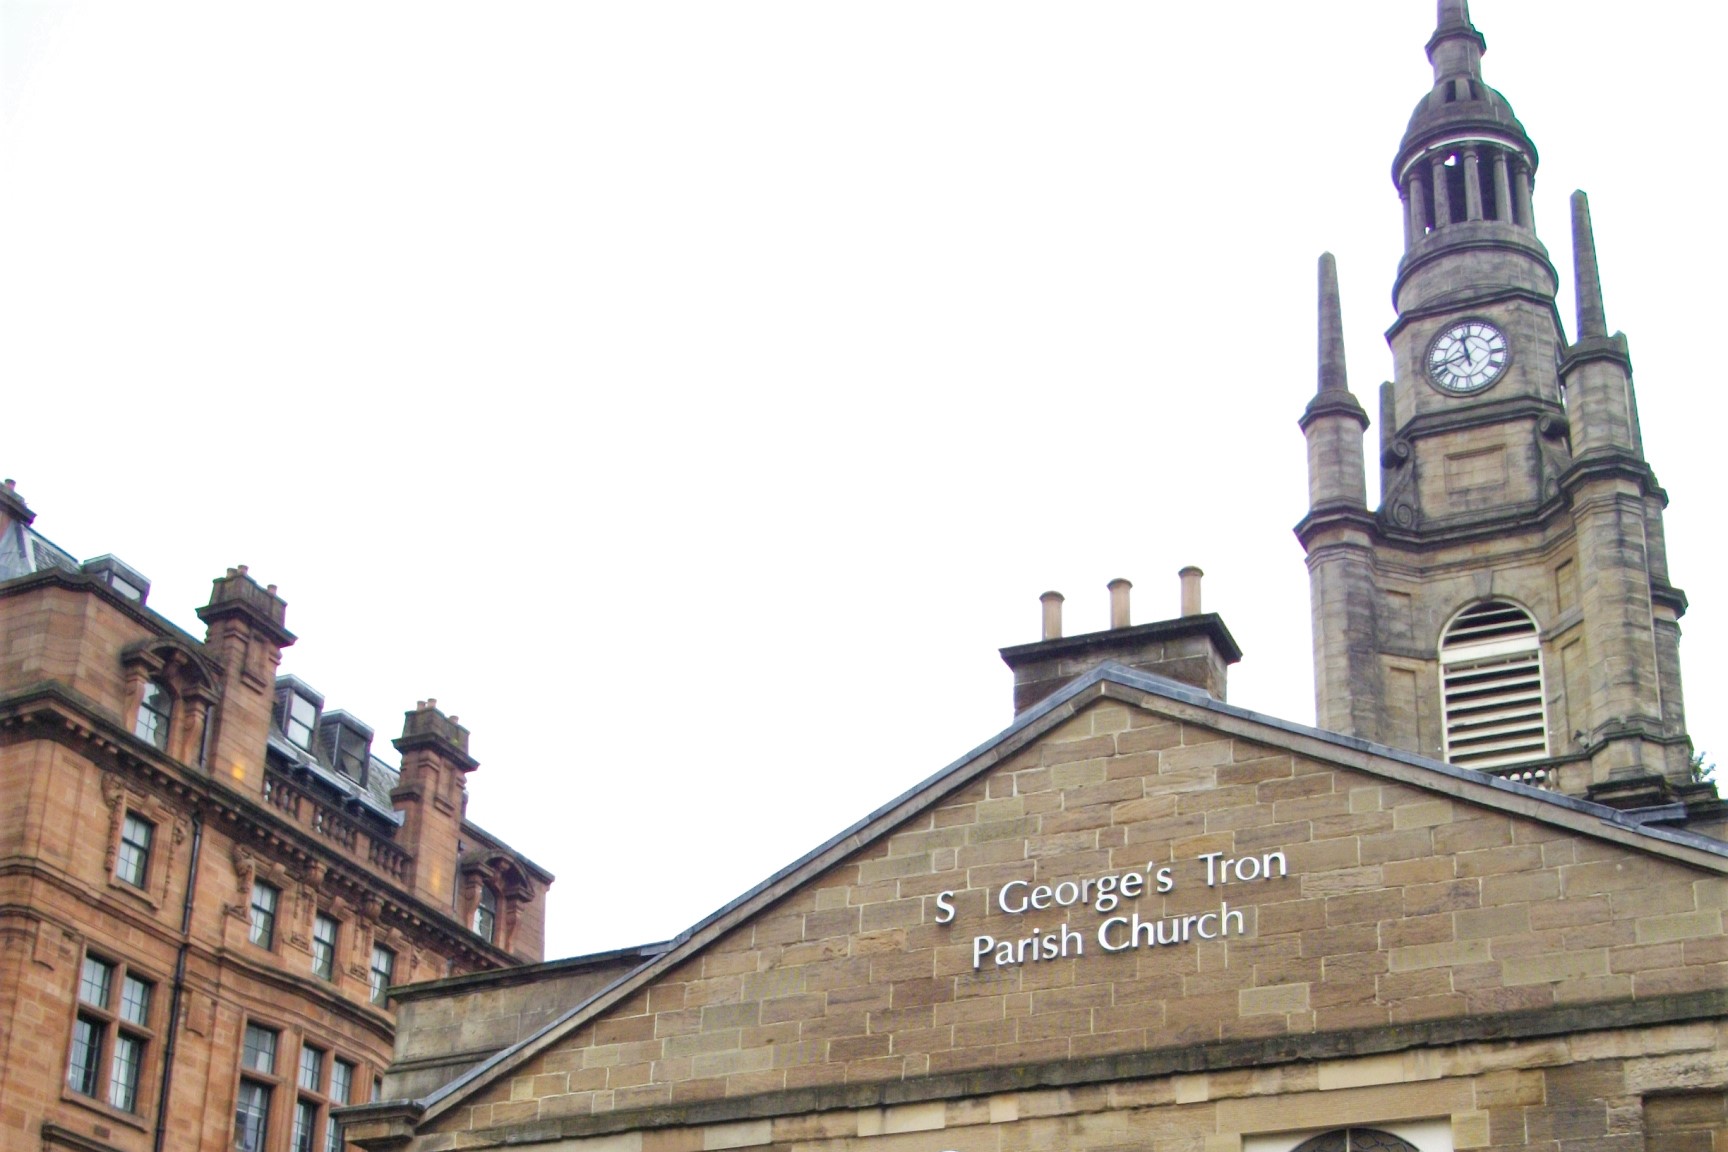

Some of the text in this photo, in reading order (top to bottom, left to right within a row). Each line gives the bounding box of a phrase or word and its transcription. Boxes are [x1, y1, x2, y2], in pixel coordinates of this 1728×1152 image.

[935, 850, 1288, 924] S George's Tron
[972, 902, 1244, 969] Parish Church
